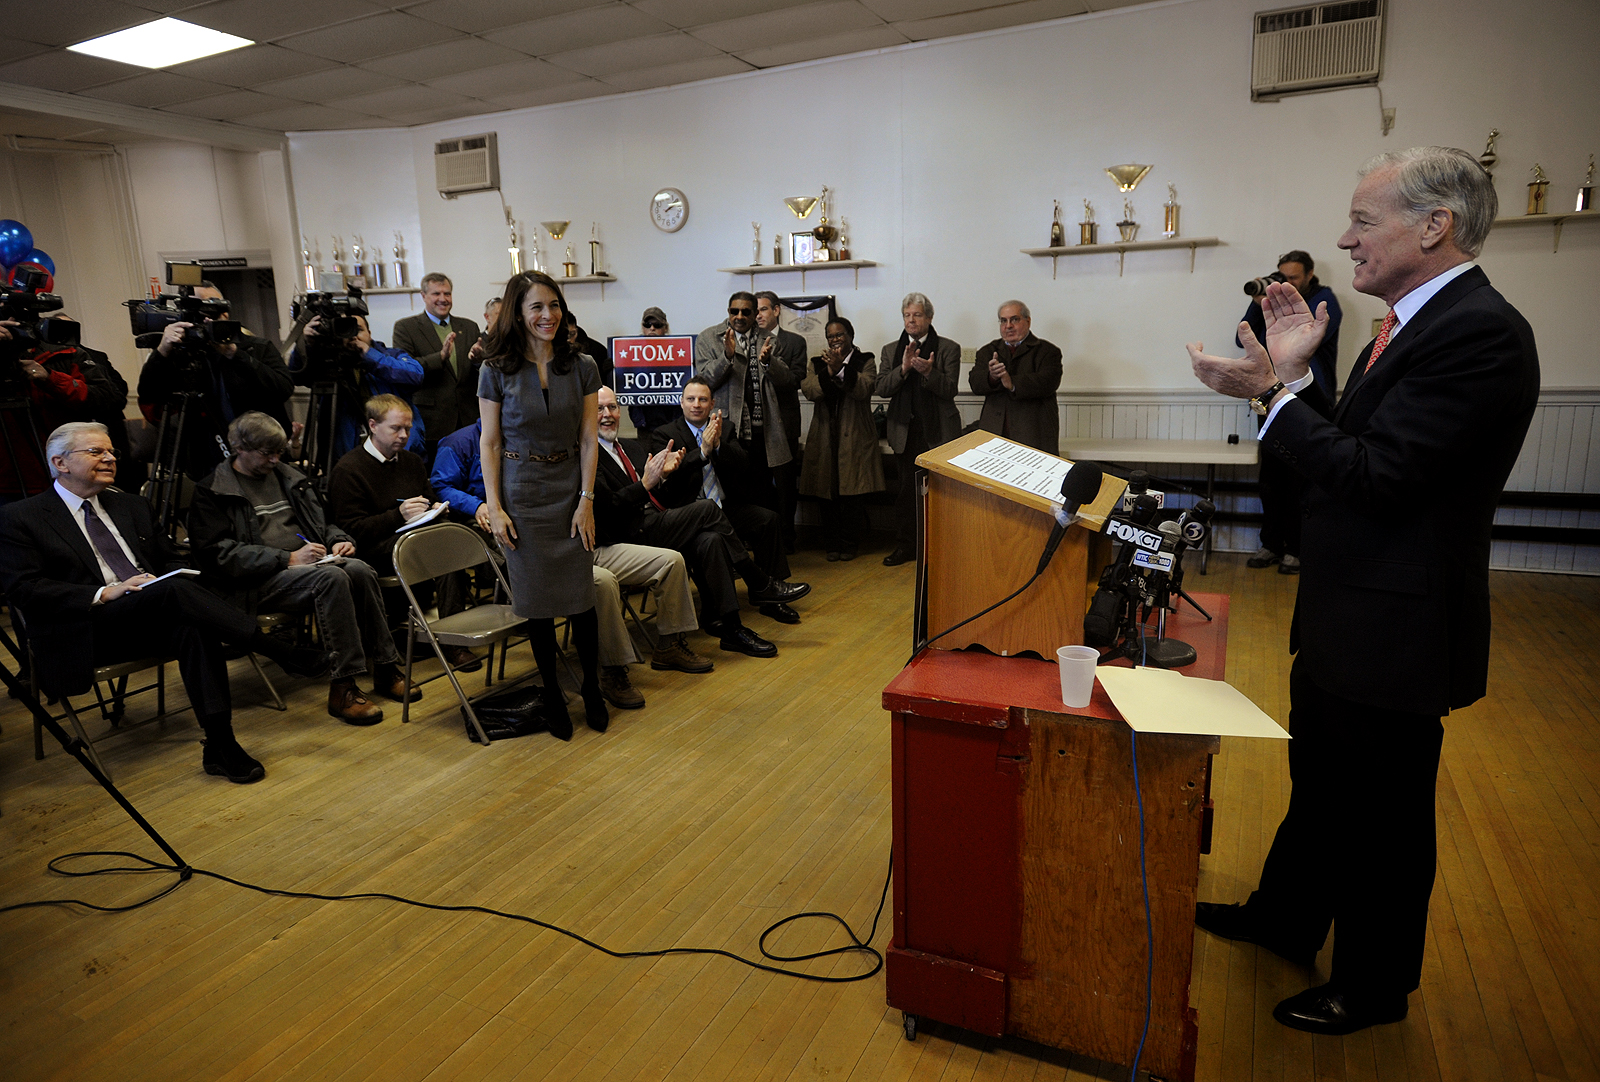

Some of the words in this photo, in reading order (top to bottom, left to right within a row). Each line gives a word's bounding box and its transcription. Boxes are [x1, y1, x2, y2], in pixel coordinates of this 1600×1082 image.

[629, 345, 675, 361] TOM
[624, 372, 685, 389] FOLEY
[637, 395, 681, 405] GOVERN
